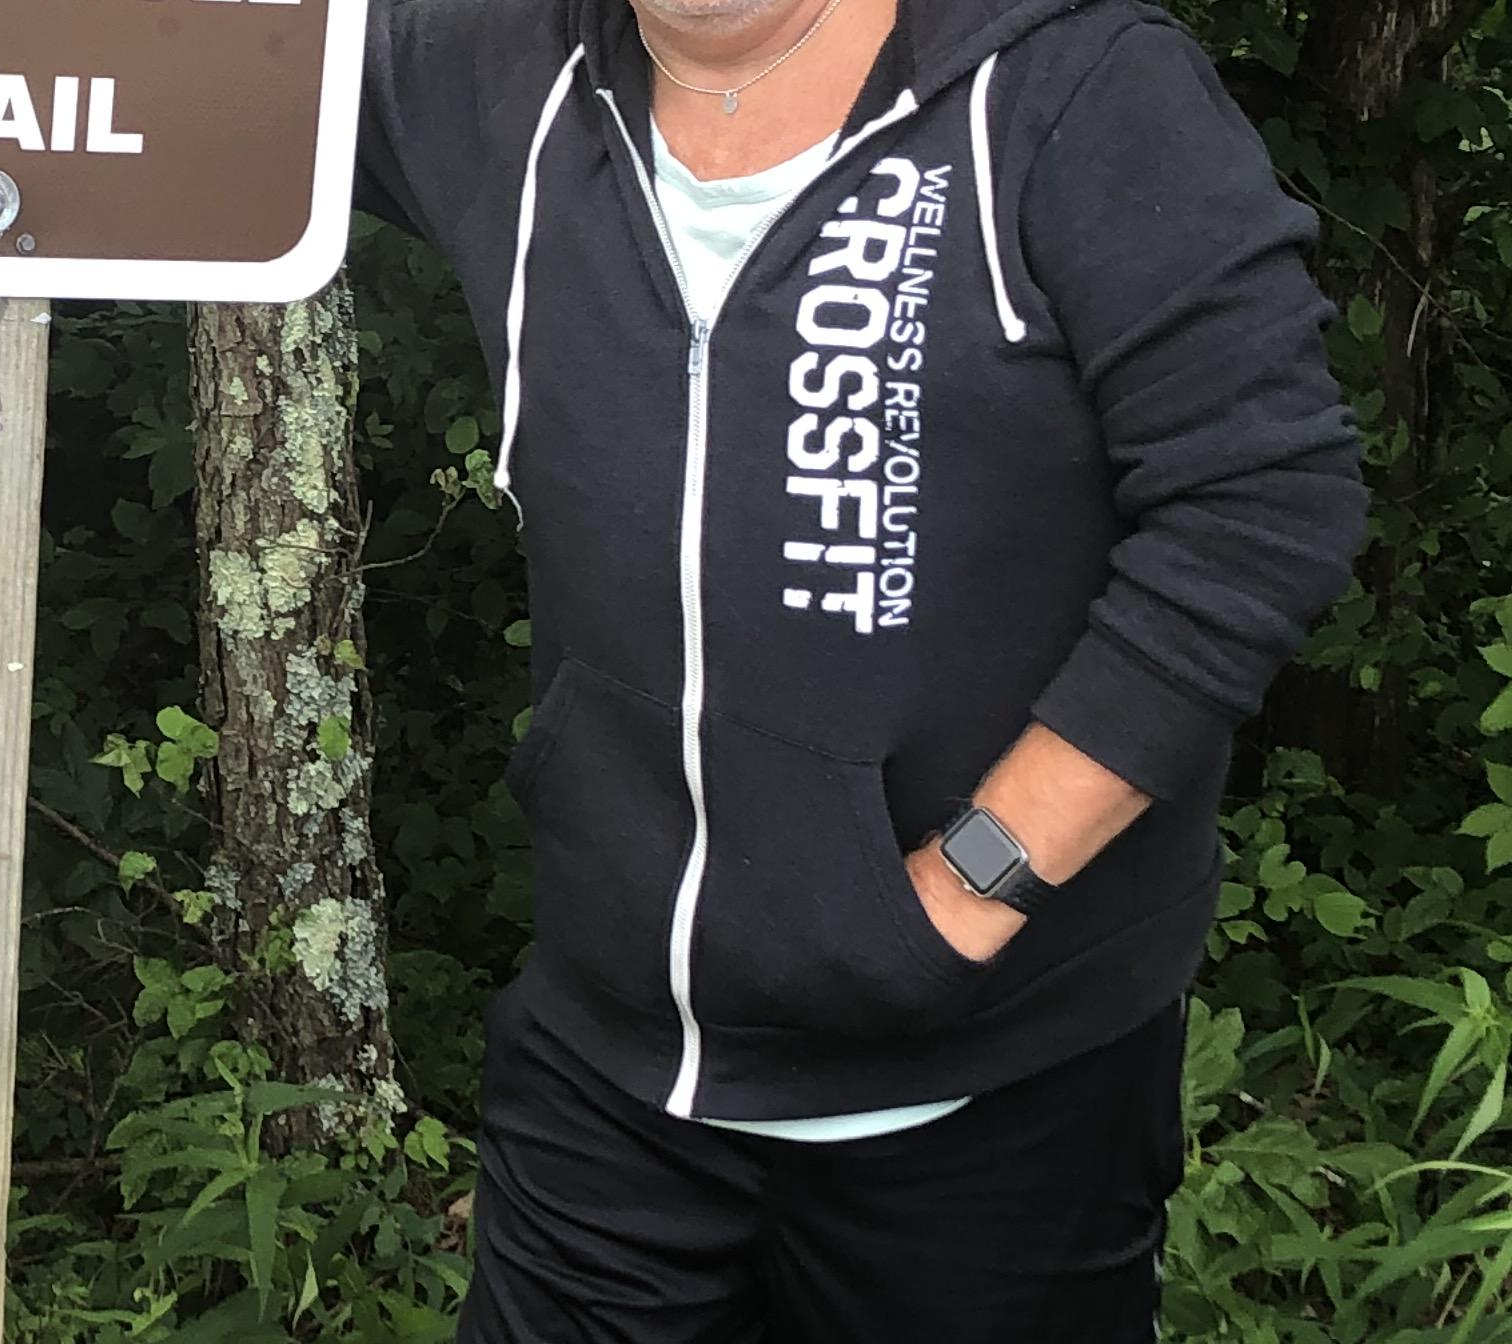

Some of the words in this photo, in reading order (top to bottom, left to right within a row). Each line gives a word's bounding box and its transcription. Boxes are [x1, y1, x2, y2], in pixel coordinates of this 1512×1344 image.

[886, 163, 954, 373] WELLNESS
[782, 156, 922, 635] CROSSFIT
[876, 380, 922, 629] REVOLUTION
